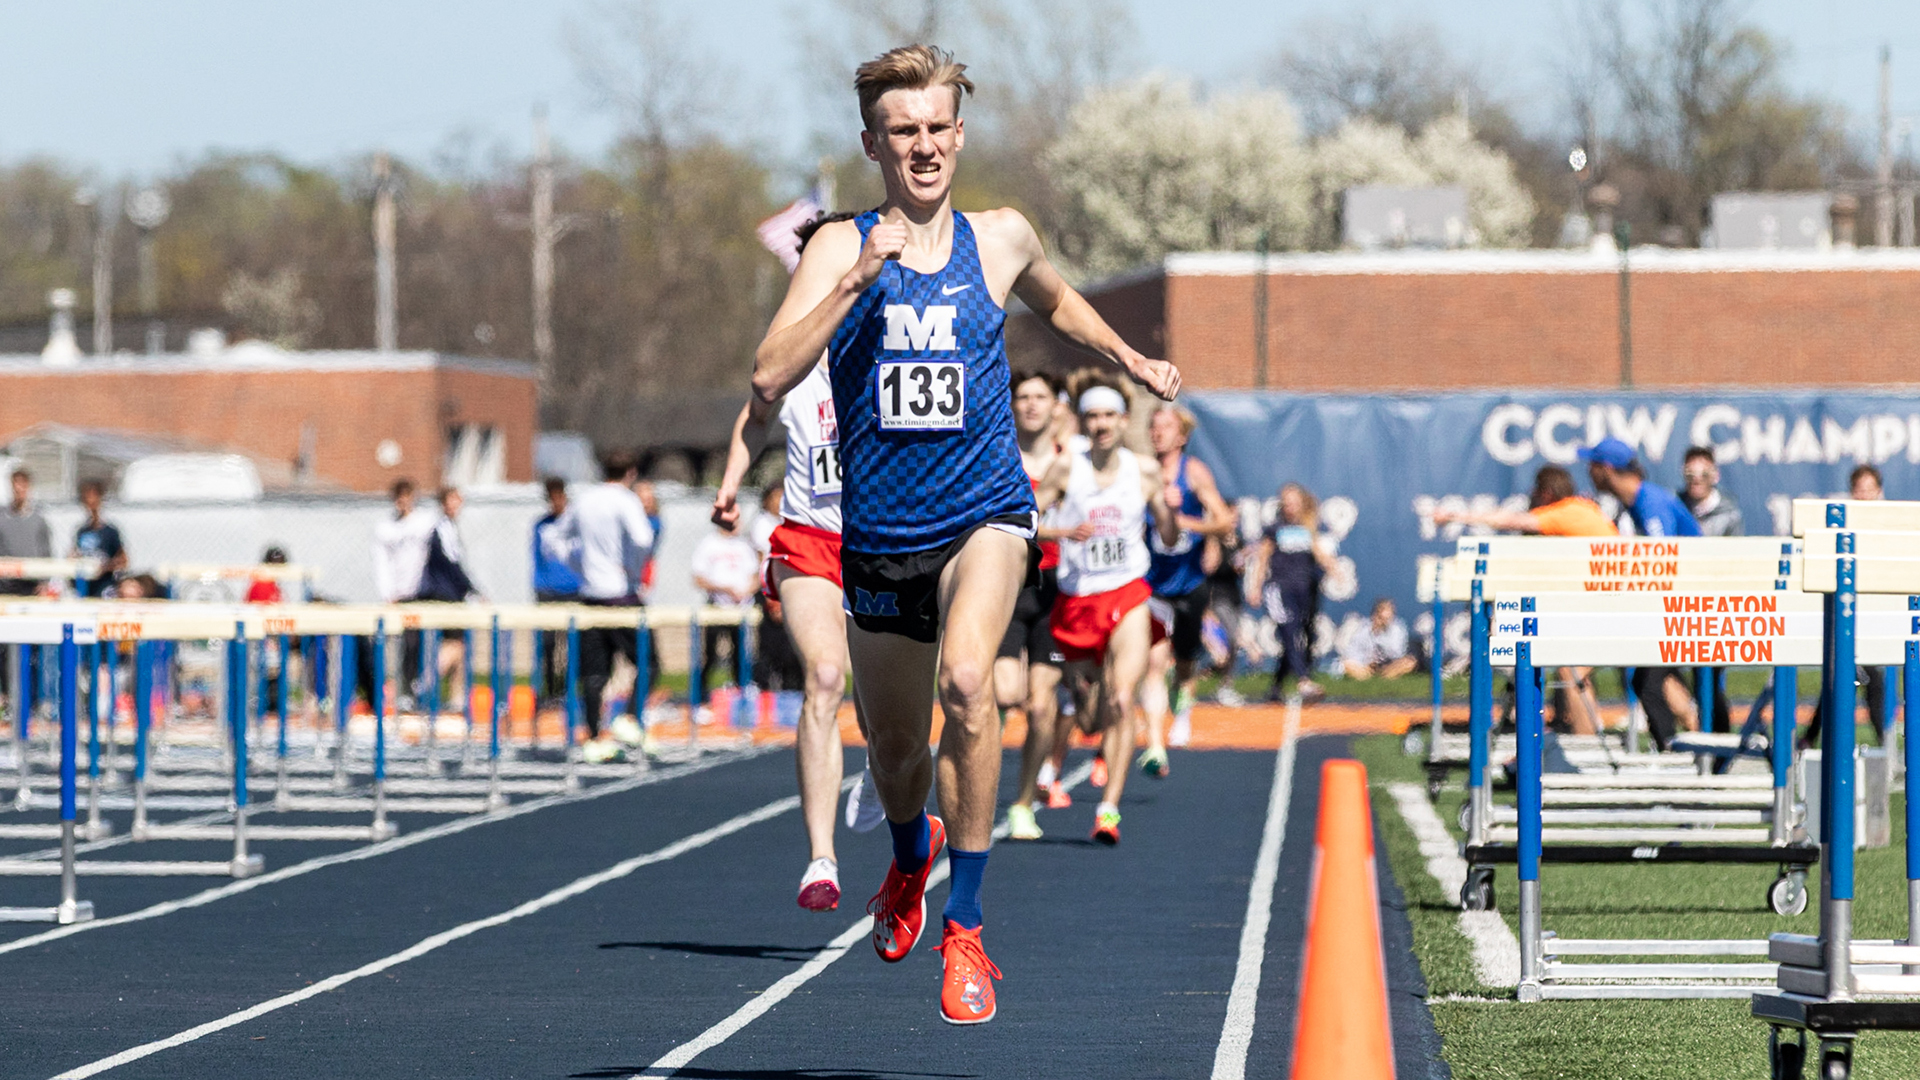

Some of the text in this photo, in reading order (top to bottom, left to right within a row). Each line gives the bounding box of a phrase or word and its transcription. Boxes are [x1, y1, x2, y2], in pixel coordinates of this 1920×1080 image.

[883, 304, 957, 350] M
[884, 366, 961, 417] 133
[1481, 403, 1678, 465] CCIW
[1590, 543, 1679, 556] WHEATON
[1589, 561, 1678, 576] WHEATON
[854, 586, 900, 616] M
[1663, 596, 1777, 612] WHEATON
[1663, 617, 1785, 636] WHEATON
[1658, 640, 1773, 663] WHEATON
